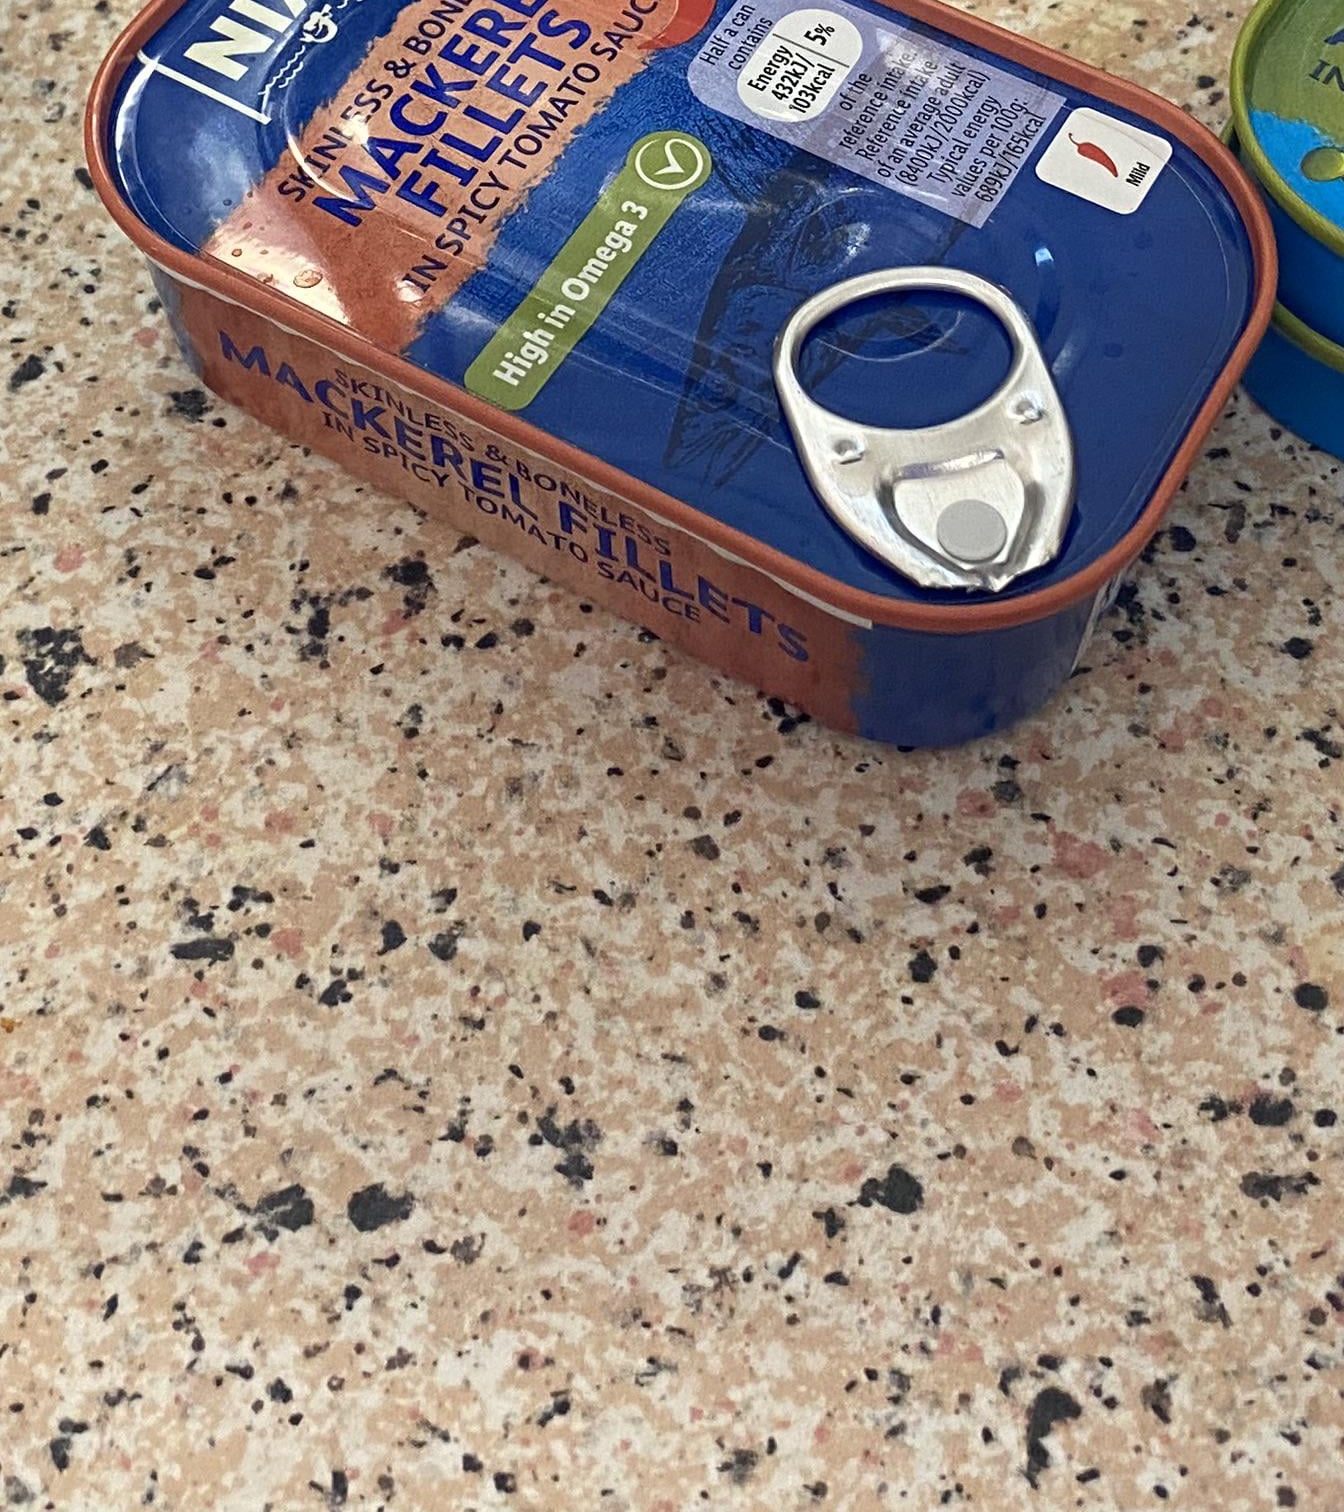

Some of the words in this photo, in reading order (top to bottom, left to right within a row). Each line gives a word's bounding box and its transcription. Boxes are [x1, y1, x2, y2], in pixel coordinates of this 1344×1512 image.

[699, 34, 730, 66] Half
[723, 28, 738, 39] a
[732, 3, 755, 27] can
[728, 16, 773, 71] contains
[747, 44, 795, 92] Energy
[804, 22, 836, 46] 5%
[277, 76, 394, 202] SKINLESS
[384, 58, 412, 80] &
[396, 9, 594, 219] FILLETS
[788, 63, 836, 114] 103kcal
[838, 92, 888, 151] reference
[840, 91, 858, 112] of
[849, 72, 873, 96] the
[855, 99, 912, 161] Reference
[901, 59, 939, 106] intake
[877, 159, 896, 178] of
[892, 143, 911, 165] an
[904, 96, 942, 150] average
[934, 59, 968, 96] adult
[894, 70, 992, 187] (8400kJ/2000kcal)
[402, 254, 449, 294] IN
[436, 171, 510, 257] SPICY
[498, 62, 601, 172] TOMATO
[926, 134, 972, 184] Typical
[962, 95, 1003, 140] energy
[952, 157, 988, 199] values
[979, 133, 1002, 162] per
[975, 112, 1047, 203] 689kJ/165kcal
[1125, 161, 1152, 188] Mild
[492, 328, 555, 386] High
[537, 304, 576, 329] in
[561, 220, 638, 302] Omega
[621, 200, 648, 220] 3
[218, 329, 538, 521] MACKEREL
[558, 500, 810, 663] FILLETS
[335, 368, 475, 451] SKINLESS
[485, 444, 510, 466] &
[516, 459, 671, 557] BONELESS
[323, 411, 355, 441] IN
[364, 437, 450, 488] SPICY
[461, 482, 588, 564] TOMATO
[597, 560, 702, 625] SAUCE
